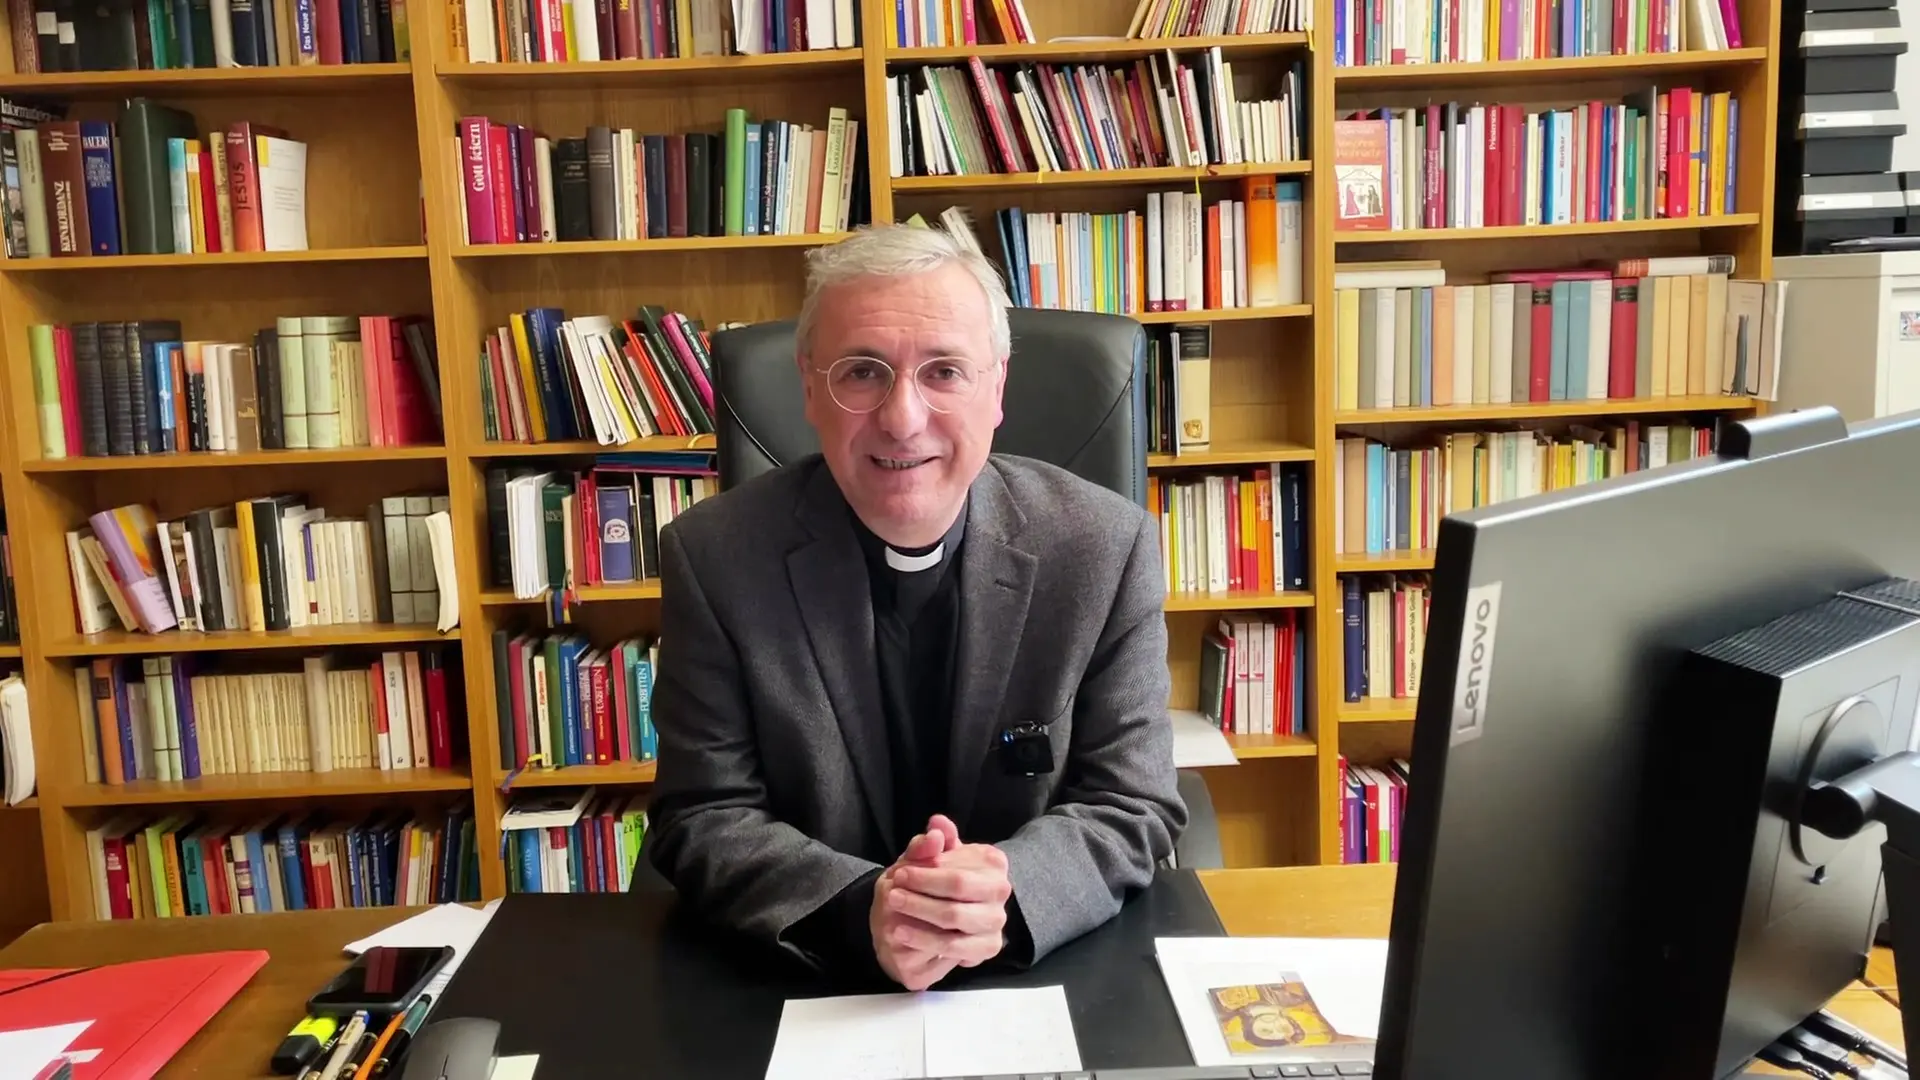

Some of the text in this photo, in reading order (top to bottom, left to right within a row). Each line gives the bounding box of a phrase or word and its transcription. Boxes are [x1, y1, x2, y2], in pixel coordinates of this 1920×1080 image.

[301, 13, 310, 34] Neue
[303, 36, 312, 50] Das
[83, 136, 109, 150] BAUER
[469, 123, 485, 192] Gott feiern
[233, 162, 251, 211] JESUS
[54, 181, 71, 252] KONKORDANZ
[1408, 611, 1416, 625] Volk
[1409, 659, 1417, 691] Ratzinger
[1457, 598, 1490, 732] Lenovo
